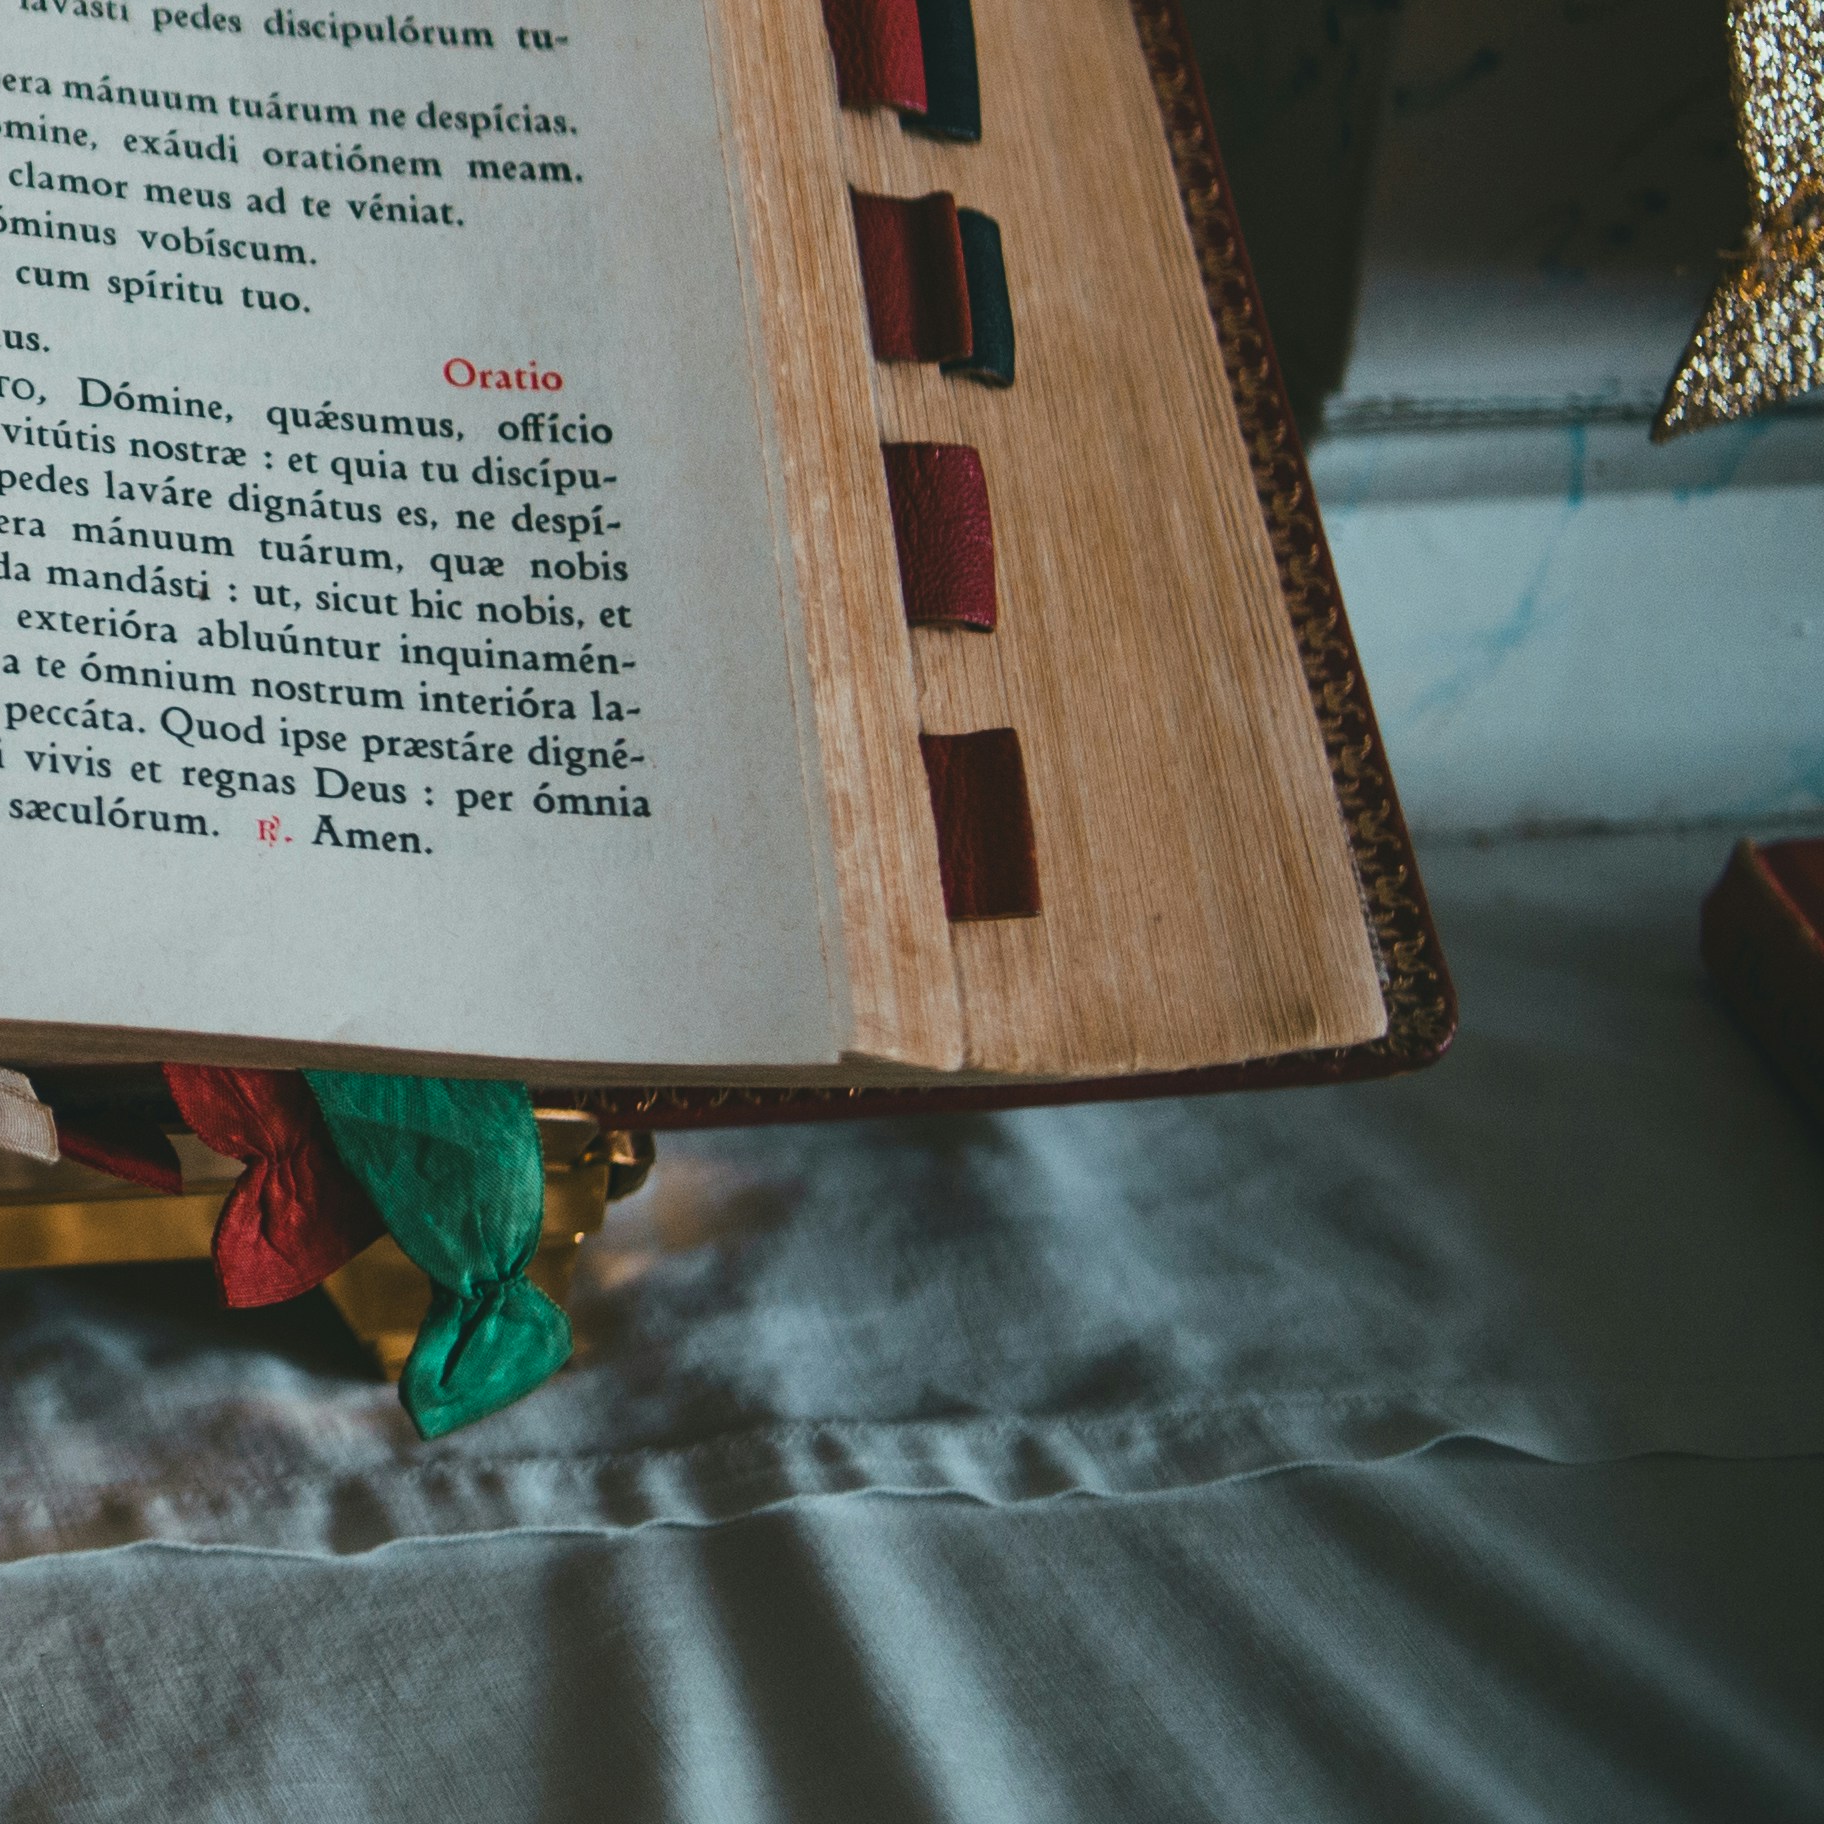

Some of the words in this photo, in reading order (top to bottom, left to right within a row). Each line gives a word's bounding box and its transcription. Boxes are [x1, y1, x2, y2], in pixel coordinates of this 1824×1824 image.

[63, 75, 219, 115] mánuum
[228, 91, 359, 126] tuárum
[369, 107, 407, 129] ne
[415, 100, 578, 140] despícias.
[123, 129, 239, 164] exáudi
[262, 143, 443, 178] oratiónem
[468, 159, 583, 184] meam.
[8, 160, 129, 200] clamor
[144, 183, 232, 211] meus
[247, 186, 287, 215] ad
[302, 195, 331, 219] te
[347, 192, 464, 227] véniat.
[138, 225, 317, 266] vobíscum.
[15, 265, 90, 292] cum
[107, 269, 224, 306] spíritu
[241, 286, 311, 314] tuo.
[443, 357, 564, 392] Oratio
[79, 377, 233, 423] Dómine,
[266, 400, 465, 442] quǽsumus,
[497, 411, 614, 445] offício
[105, 469, 213, 510] laváre
[227, 482, 383, 524] dignátus
[396, 506, 438, 530] es,
[455, 509, 496, 532] ne
[511, 502, 622, 543] despí-
[72, 515, 235, 558] mánuum
[259, 533, 404, 573] tuárum,
[429, 553, 505, 583] quæ
[530, 550, 629, 582] nobis
[17, 607, 178, 644] exterióra
[197, 618, 381, 662] abluúntur
[400, 633, 636, 677] inquinamén-
[4, 698, 146, 734] peccáta.
[160, 706, 266, 748] Quod
[280, 716, 347, 758] ipse
[361, 730, 514, 765] præstáre
[527, 734, 645, 777] digné-
[9, 795, 219, 837] sæculórum.
[312, 814, 433, 855] Amen.
